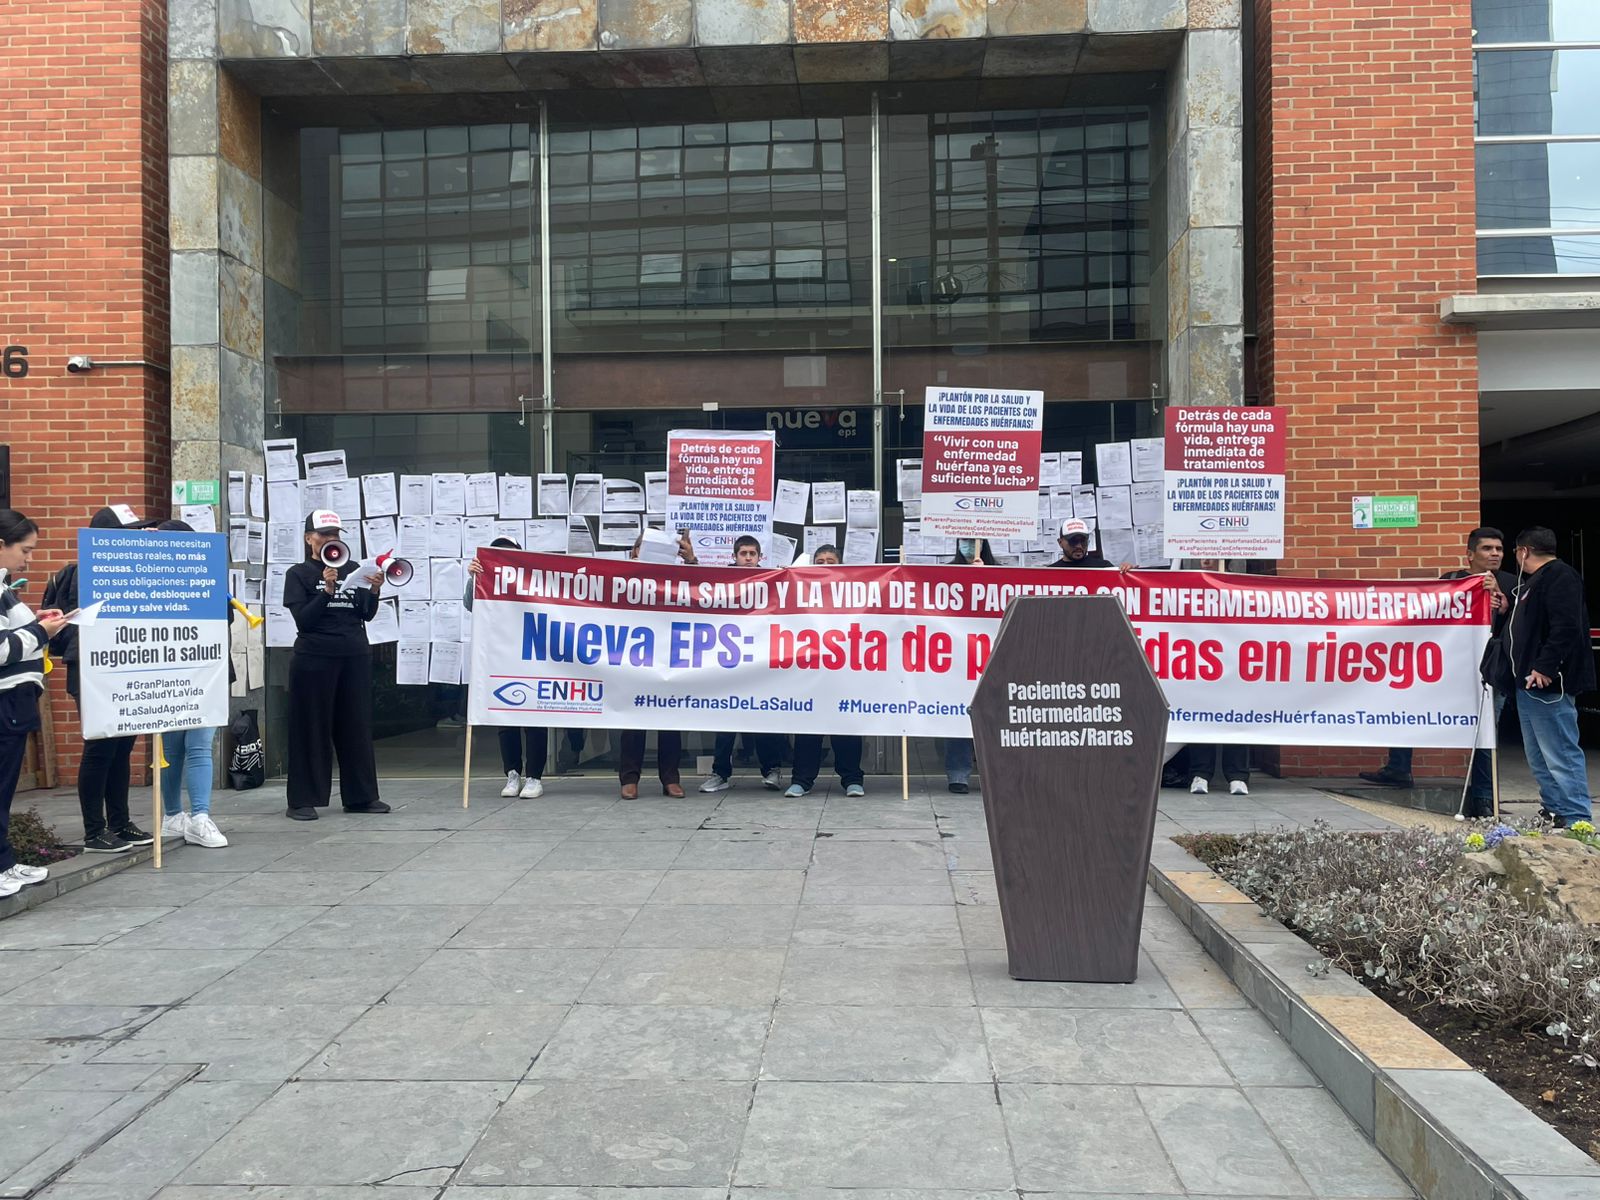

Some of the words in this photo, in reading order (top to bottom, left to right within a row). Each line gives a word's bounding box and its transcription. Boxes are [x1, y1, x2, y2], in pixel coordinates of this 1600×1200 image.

[0, 346, 28, 378] 6
[939, 391, 972, 402] ¡PLANTÓN
[975, 394, 988, 403] POR
[991, 394, 999, 403] LA
[1002, 395, 1023, 404] SALUD
[1026, 396, 1030, 405] Y
[929, 404, 937, 412] LA
[940, 404, 956, 413] VIDA
[958, 405, 967, 414] DE
[969, 406, 982, 414] LOS
[984, 406, 1020, 416] PACIENTES
[1023, 408, 1037, 417] CON
[1179, 410, 1219, 420] Detrás
[1223, 410, 1238, 420] de
[1241, 410, 1271, 420] cada
[766, 410, 856, 430] nueva
[934, 416, 988, 426] ENFERMEDADES
[991, 417, 1033, 428] HUÉRFANAS!
[838, 429, 856, 438] eps
[1176, 422, 1223, 432] fórmula
[1226, 422, 1248, 435] hay
[1252, 424, 1274, 432] una
[934, 435, 969, 447] “Vivir
[972, 440, 994, 448] con
[997, 441, 1018, 449] una
[1184, 434, 1213, 446] vida,
[1216, 436, 1265, 447] entrega
[681, 443, 716, 452] Detrás
[719, 444, 731, 453] de
[734, 445, 760, 454] cada
[1184, 446, 1246, 457] inmediata
[1249, 446, 1264, 456] de
[679, 454, 719, 463] fórmula
[722, 455, 740, 466] hay
[944, 449, 1016, 460] enfermedad
[936, 461, 990, 472] huérfana
[992, 465, 1005, 475] ya
[1009, 465, 1022, 474] es
[1184, 458, 1264, 469] tratamientos
[686, 464, 710, 474] vida,
[713, 466, 755, 475] entrega
[686, 475, 738, 485] inmediata
[741, 475, 754, 485] de
[931, 474, 991, 484] suficiente
[994, 475, 1034, 486] lucha”
[1177, 477, 1212, 488] ¡PLANTÓN
[1214, 479, 1228, 487] POR
[1231, 479, 1239, 487] LA
[1242, 479, 1264, 487] SALUD
[1267, 479, 1272, 487] Y
[685, 486, 754, 495] tratamientos
[1167, 490, 1176, 499] LA
[1178, 490, 1195, 499] VIDA
[1197, 490, 1206, 499] DE
[1209, 490, 1222, 499] LOS
[1225, 490, 1262, 499] PACIENTES
[1265, 490, 1279, 499] CON
[680, 501, 708, 511] ¡PLANTÓN
[974, 498, 1003, 507] ENHU
[1173, 502, 1229, 511] ENFERMEDADES
[1232, 501, 1275, 511] HUÉRFANAS!
[720, 513, 752, 522] PACIENTES
[1219, 518, 1249, 527] ENHU
[675, 523, 724, 531] ENFERMEDADES
[726, 523, 763, 532] HUÉRFANAS!
[92, 537, 109, 546] Los
[112, 538, 168, 547] colombianos
[170, 539, 211, 548] necesitan
[92, 551, 143, 561] respuestas
[145, 552, 173, 560] reales,
[188, 552, 206, 560] más
[136, 564, 175, 572] Gobierno
[177, 565, 207, 574] cumpla
[130, 577, 188, 587] obligaciones:
[190, 578, 216, 587] pague
[93, 590, 101, 599] lo
[123, 590, 148, 600] debe,
[150, 590, 200, 600] desbloquee
[494, 564, 604, 602] ¡PLANTÓN
[612, 576, 656, 605] POR
[665, 580, 691, 607] LA
[698, 581, 768, 610] SALUD
[776, 582, 789, 608] Y
[796, 581, 824, 608] LA
[830, 581, 882, 608] VIDA
[889, 582, 916, 609] DE
[923, 582, 964, 610] LOS
[1150, 588, 1328, 620] ENFERMEDADES
[1336, 586, 1472, 620] HUÉRFANAS!
[132, 605, 137, 614] y
[139, 603, 162, 611] salve
[164, 603, 190, 611] vidas.
[115, 626, 146, 644] ¡Que
[152, 627, 168, 641] no
[174, 626, 198, 640] nos
[90, 646, 158, 668] negocien
[164, 646, 176, 662] la
[180, 644, 221, 661] salud!
[521, 612, 654, 667] Nueva
[670, 622, 754, 668] EPS:
[769, 623, 887, 672] basta
[902, 625, 952, 672] de
[1239, 640, 1292, 682] en
[1306, 632, 1442, 690] riesgo
[126, 679, 190, 690] #GranPlanton
[112, 688, 204, 702] PorLaSaludYLaVida
[538, 680, 603, 701] ENHU
[1008, 681, 1086, 700] Pacientes
[1090, 682, 1121, 700] con
[634, 694, 813, 712] #HuérfanasDeLaSalud
[119, 702, 199, 716] #LaSaludAgoniza
[1008, 705, 1122, 724] Enfermedades
[118, 717, 202, 731] #MuerenPacientes
[1000, 727, 1134, 748] Huérfanas/Raras
